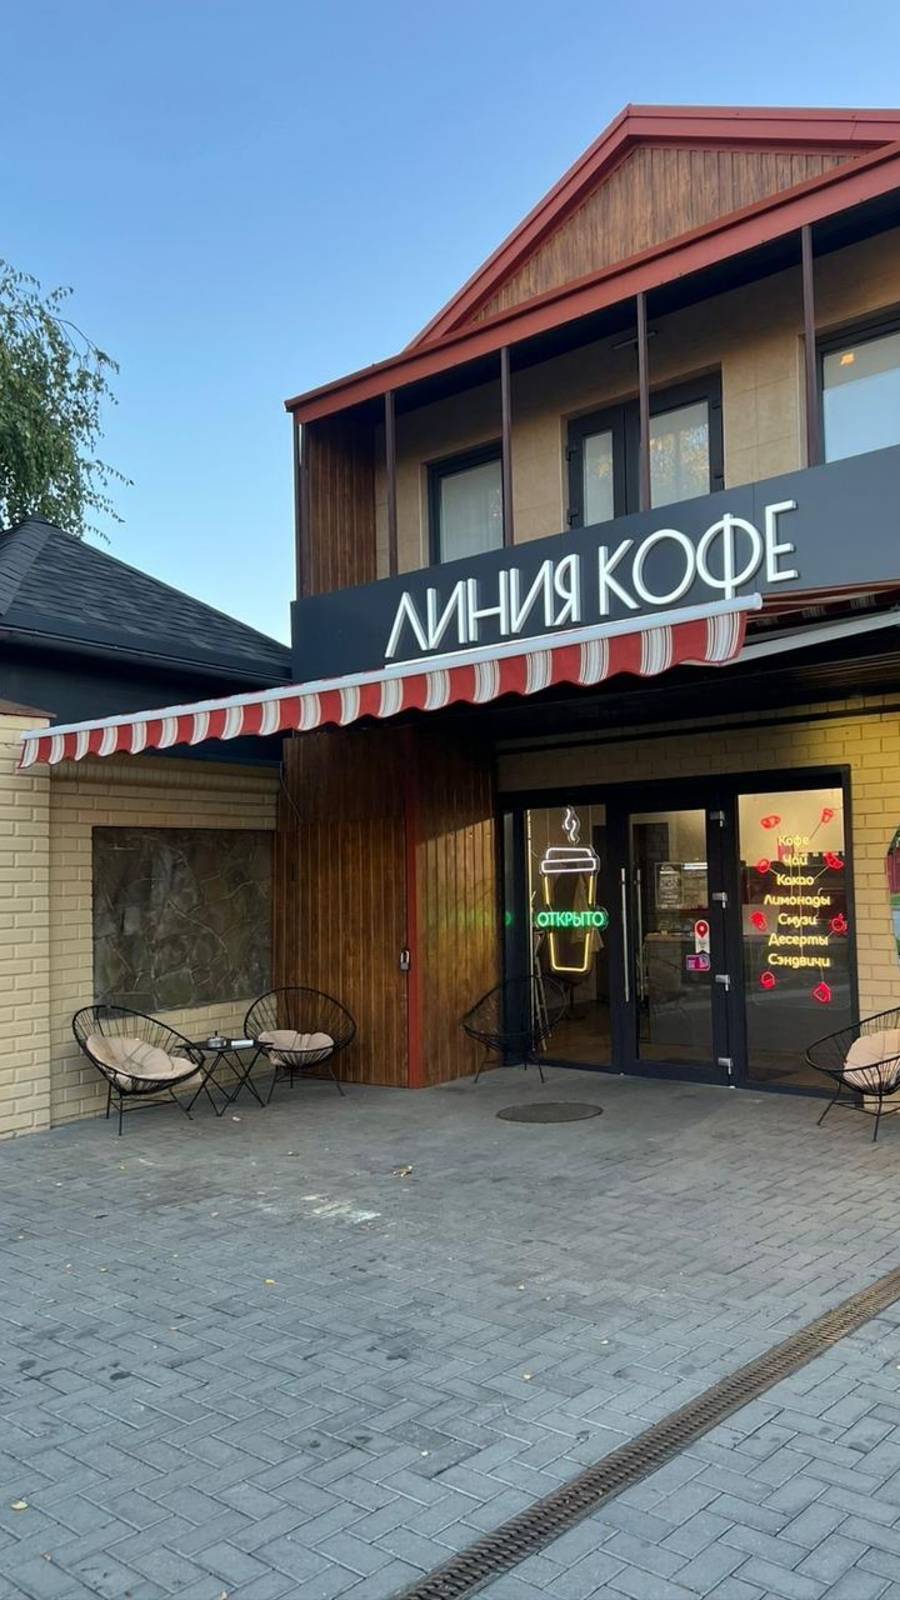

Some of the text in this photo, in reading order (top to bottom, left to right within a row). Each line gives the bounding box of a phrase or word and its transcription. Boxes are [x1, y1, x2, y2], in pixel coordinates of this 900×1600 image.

[385, 500, 798, 658] ЛИНИЯ КОФЕ
[778, 835, 809, 848] Кофе
[782, 853, 808, 866] Чай
[776, 873, 815, 886] Какао
[764, 894, 831, 908] Лимонады
[537, 911, 604, 927] ОТКРЫТО
[778, 913, 817, 928] Смузи
[768, 932, 829, 947] Десерты
[768, 953, 831, 969] Сэндвичи
